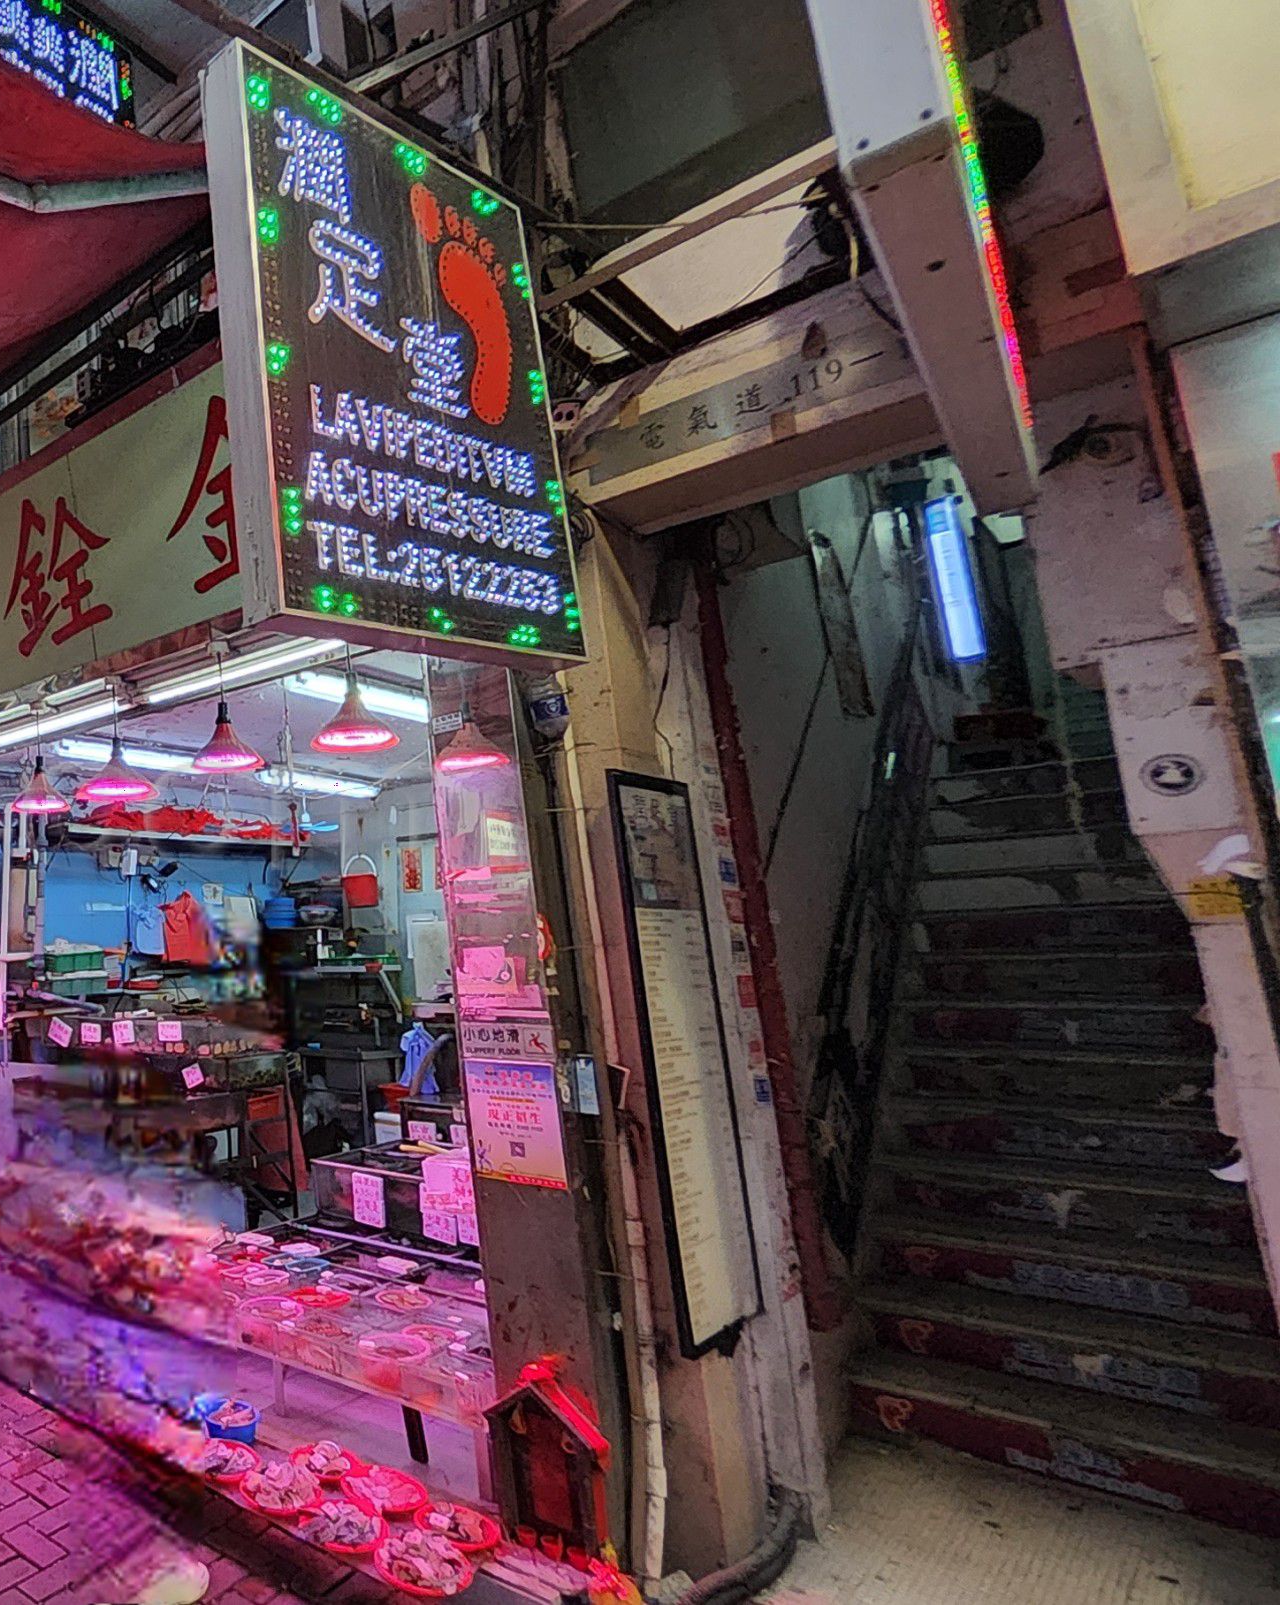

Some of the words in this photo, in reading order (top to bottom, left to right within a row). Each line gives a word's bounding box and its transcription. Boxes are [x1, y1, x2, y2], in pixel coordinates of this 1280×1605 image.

[640, 384, 770, 450] 電氣道
[305, 451, 557, 559] ACUPRESSURE
[463, 1027, 520, 1043] 小心地滑
[465, 1046, 496, 1055] SLIPPERY
[498, 1047, 521, 1056] FLOOR
[488, 1108, 541, 1125] 現正招生
